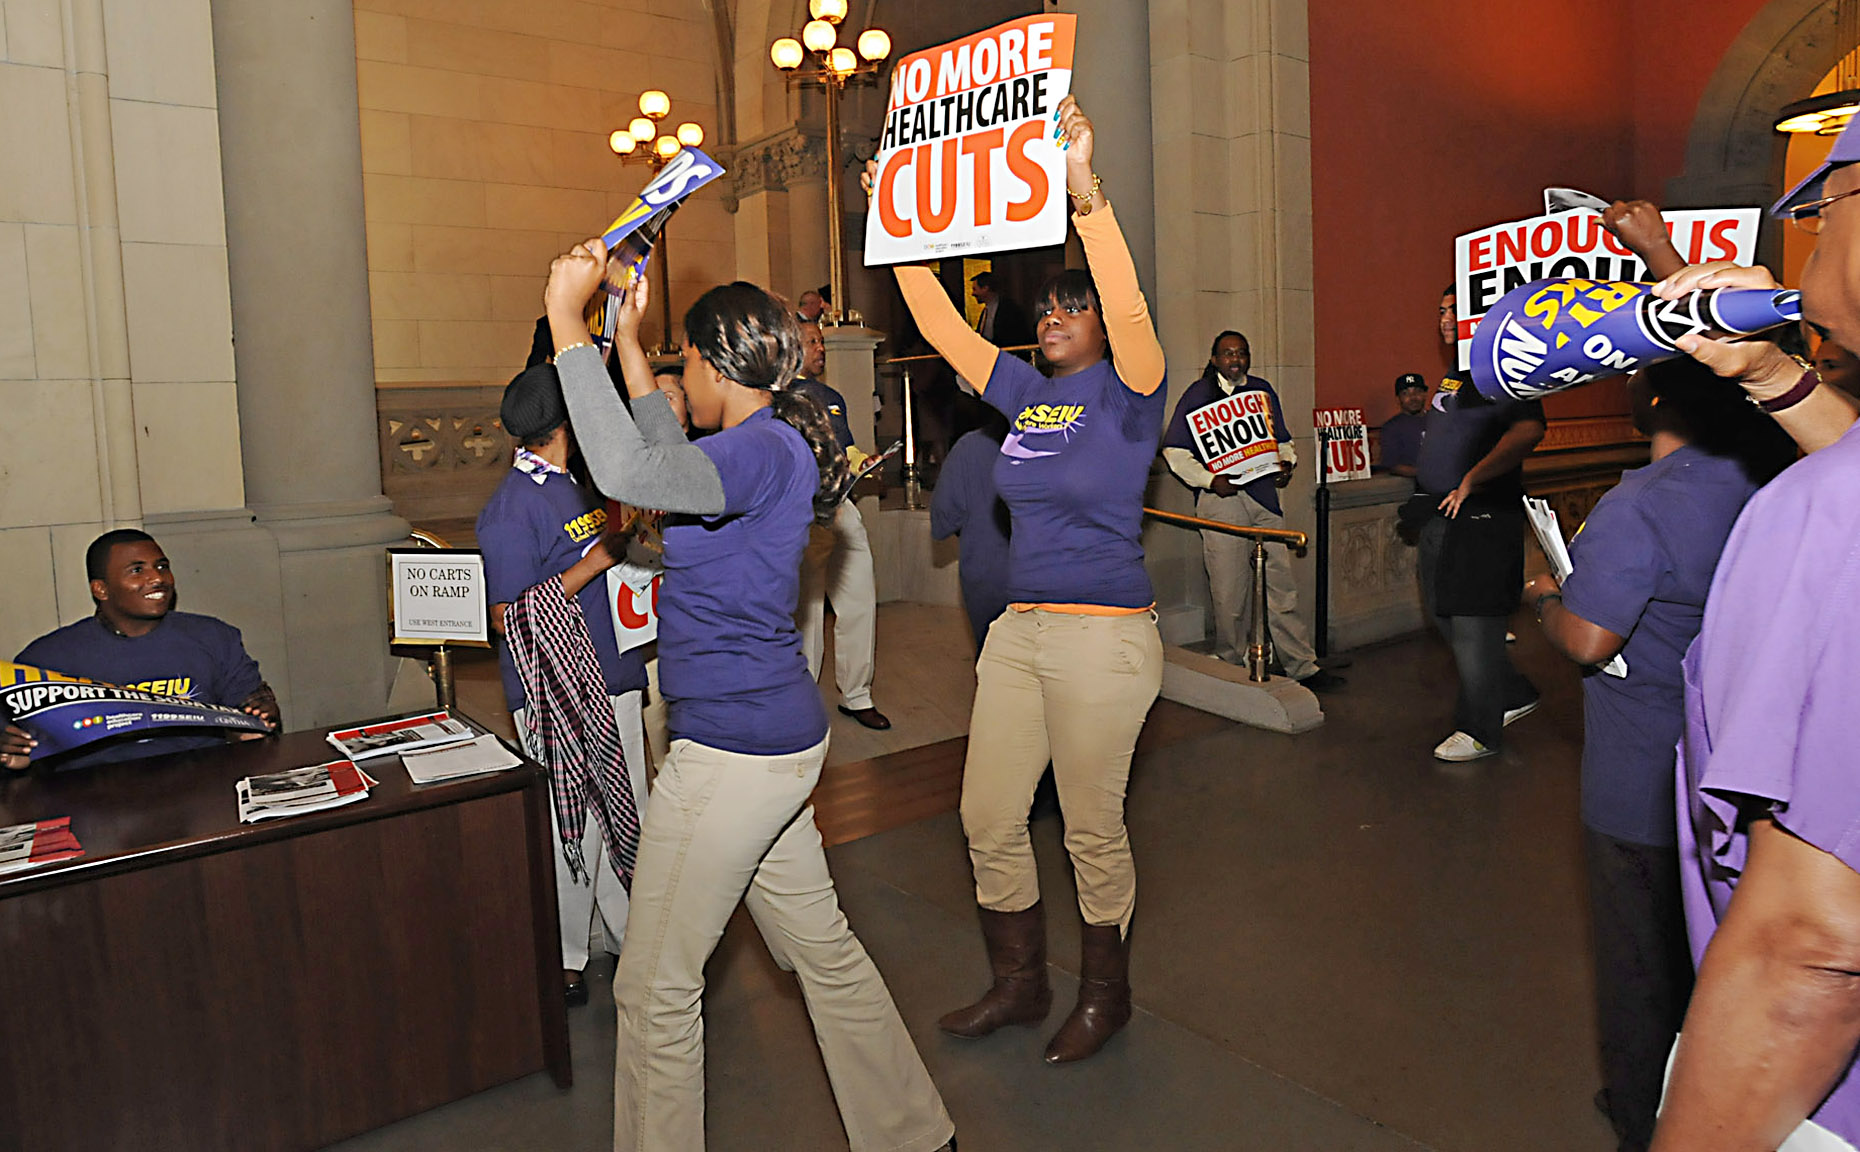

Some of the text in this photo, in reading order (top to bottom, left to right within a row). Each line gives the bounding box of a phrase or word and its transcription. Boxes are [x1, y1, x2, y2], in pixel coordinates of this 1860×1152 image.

[889, 22, 1054, 111] NO MORE
[883, 72, 1048, 150] HEALTHCARE
[878, 120, 1049, 238] CUTS
[1688, 219, 1740, 264] IS
[1316, 409, 1362, 427] NO MORE
[1200, 413, 1271, 460] ENOU
[1211, 460, 1223, 471] NO
[1222, 451, 1245, 467] MORE
[1326, 439, 1366, 474] UTS
[407, 568, 472, 581] NO CARTS
[410, 585, 470, 598] ON RAMP
[422, 619, 438, 627] WEST
[439, 620, 473, 628] ENTRANCE
[6, 685, 107, 714] SUPPORT
[110, 689, 150, 700] THE
